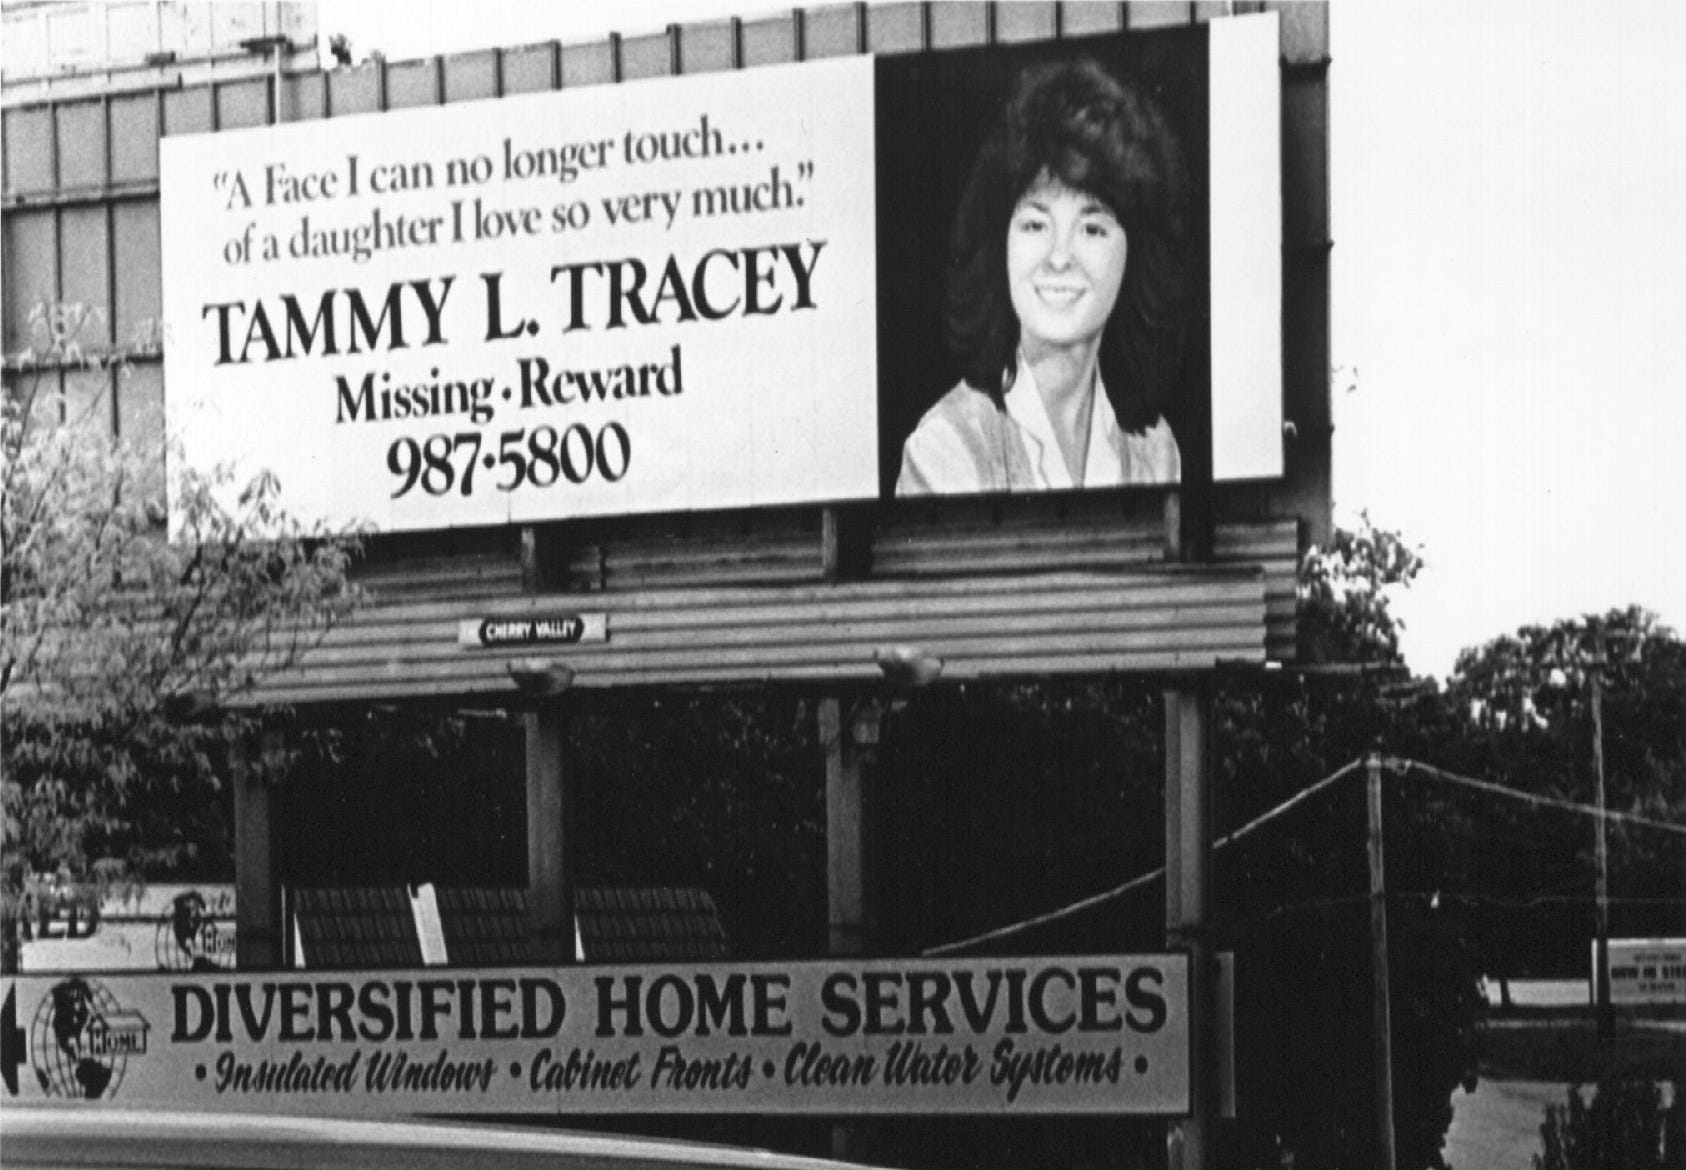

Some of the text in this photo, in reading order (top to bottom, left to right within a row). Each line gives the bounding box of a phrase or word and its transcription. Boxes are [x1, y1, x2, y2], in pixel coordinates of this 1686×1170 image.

[264, 162, 338, 205] Face
[345, 155, 360, 195] I
[370, 157, 434, 193] can
[446, 153, 492, 185] no
[502, 138, 615, 182] longer
[223, 223, 253, 264] of
[262, 231, 280, 260] a
[288, 207, 444, 262] daughter
[451, 201, 466, 243] I
[474, 198, 542, 239] love
[551, 198, 590, 231] so
[603, 186, 682, 229] very
[202, 239, 828, 366] TAMMY L. TRACEY
[486, 619, 576, 640] CHERRY VALLEY
[171, 967, 1167, 1042] DIVERSIFIED HOME SERVICES
[216, 1037, 1124, 1103] Insulated Windows Cabinet Fronts Clean Water Systems
